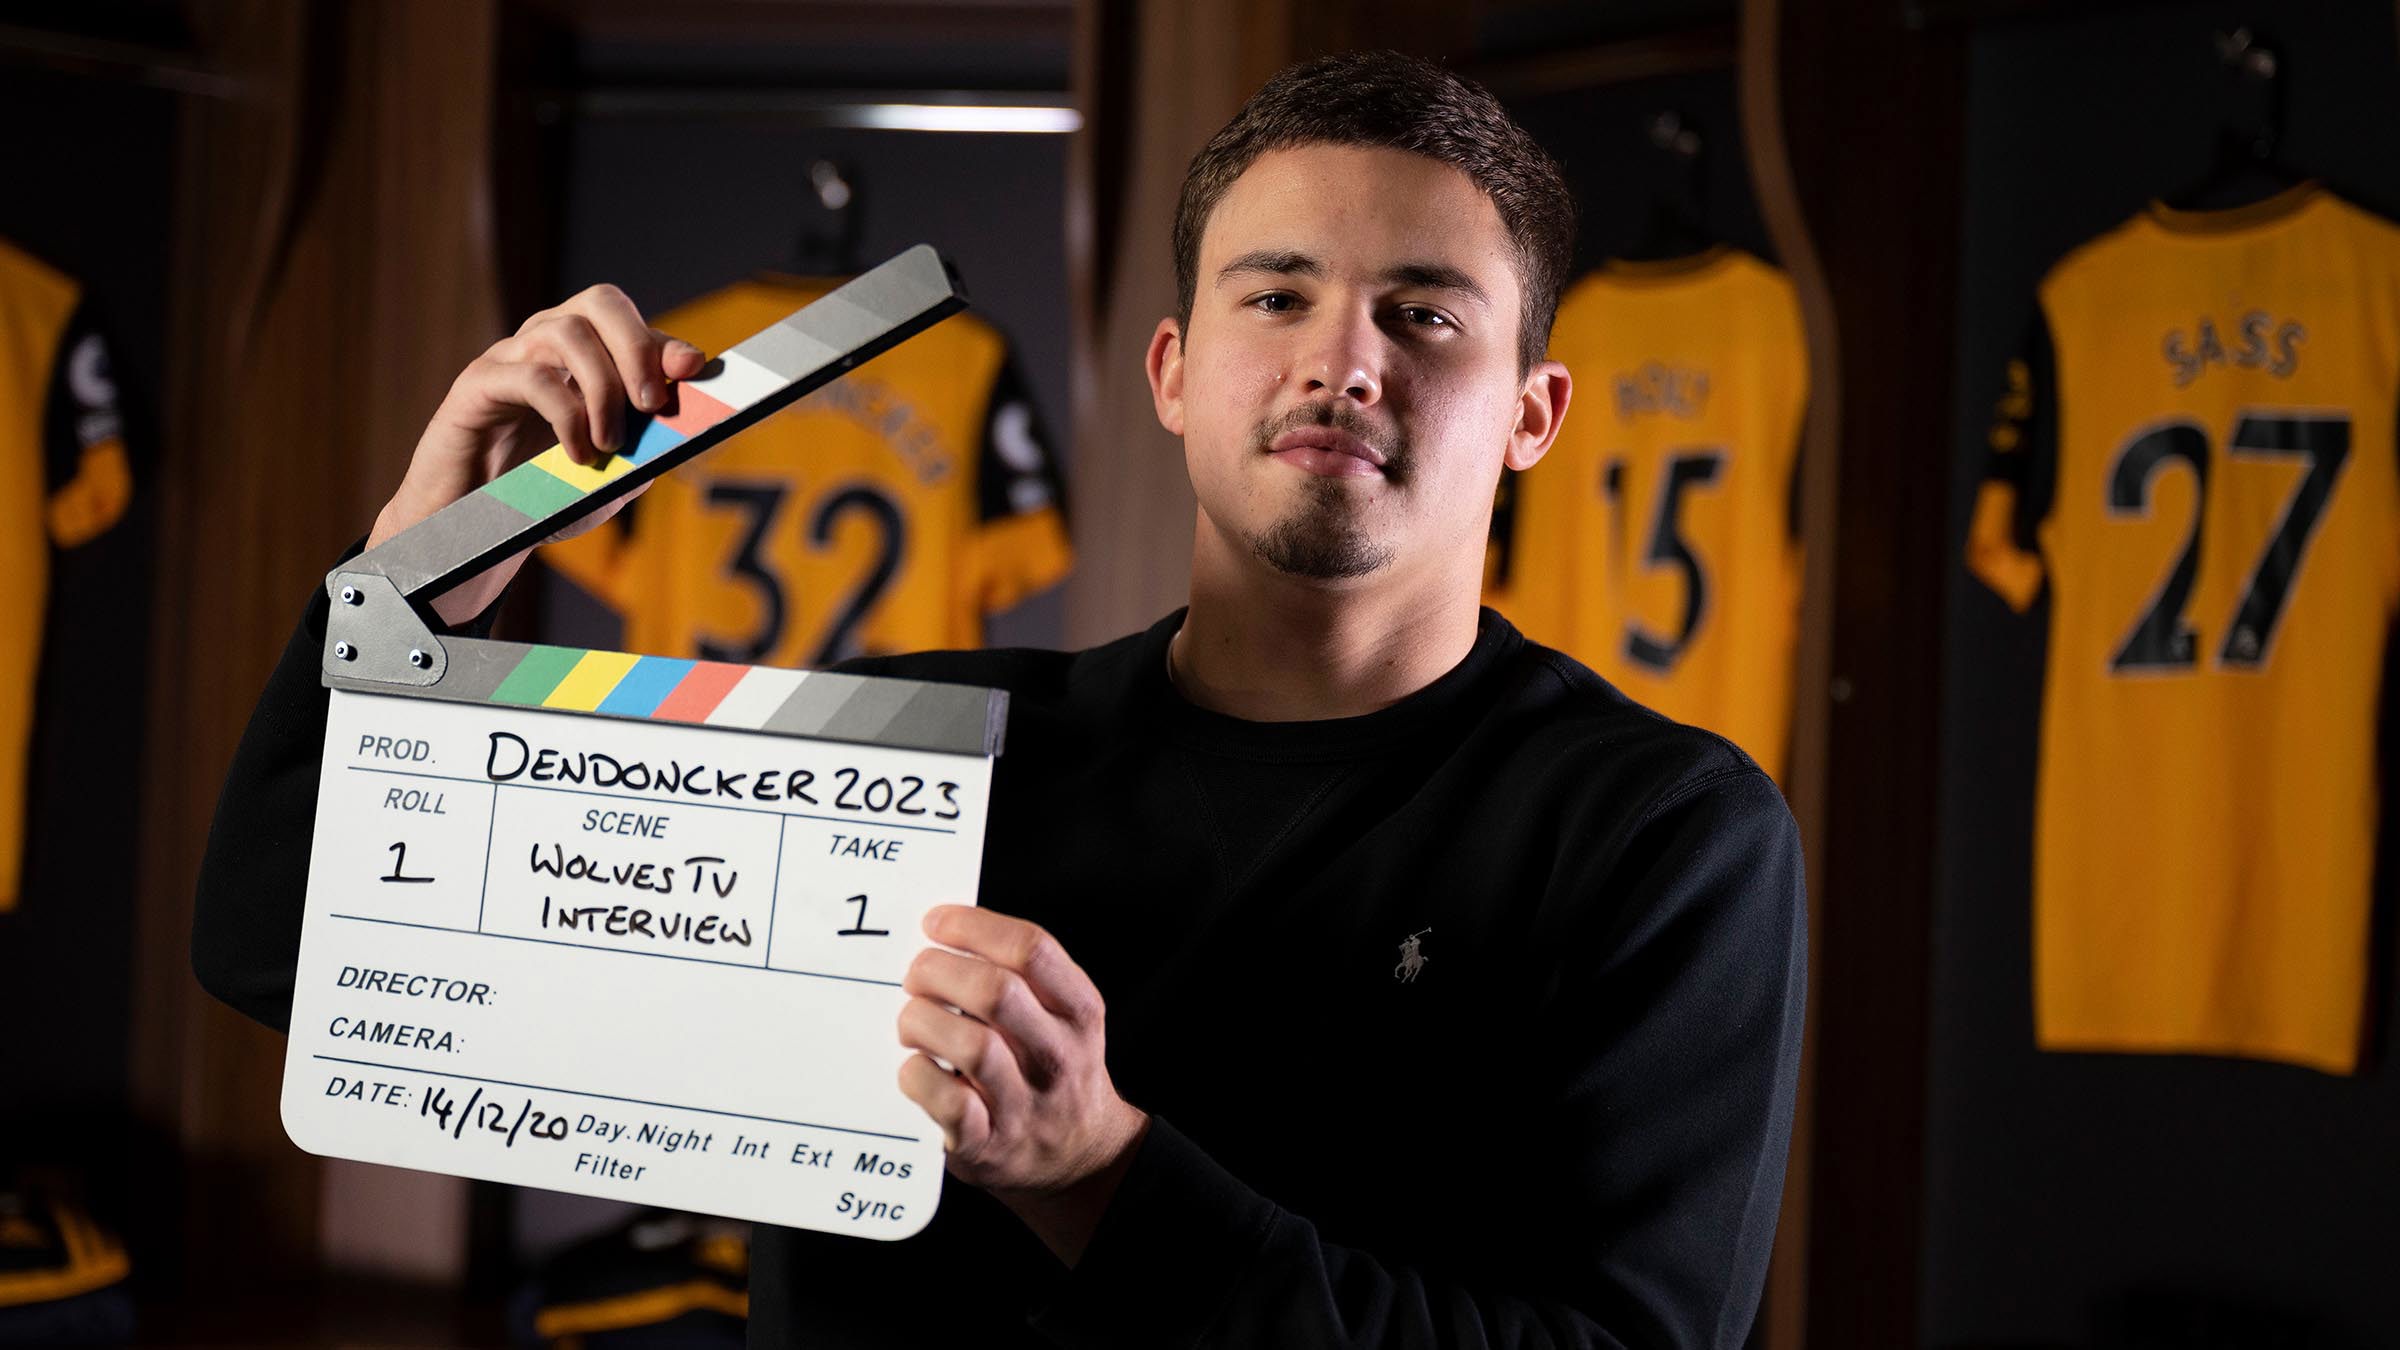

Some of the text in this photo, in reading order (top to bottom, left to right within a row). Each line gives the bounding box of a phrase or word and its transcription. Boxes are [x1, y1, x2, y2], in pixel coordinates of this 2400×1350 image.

[2104, 408, 2353, 677] 27
[695, 478, 912, 664] 32
[358, 734, 437, 764] PROD.
[487, 732, 961, 820] DENDONCKER 2023
[383, 788, 446, 815] ROLL
[582, 809, 670, 839] SCENE
[379, 842, 435, 884] 1
[530, 842, 675, 894] WOLVES
[829, 834, 904, 862] TAKE
[541, 896, 752, 947] INTERVIEW
[837, 894, 890, 936] 1
[336, 966, 498, 1006] DIRECTOR:
[329, 1016, 465, 1054] CAMERA:
[325, 1076, 413, 1108] DATE:
[420, 1087, 569, 1148] 14/12/20
[574, 1152, 646, 1181] Filter
[732, 1135, 771, 1159] Int
[791, 1143, 833, 1168] Ext
[853, 1152, 913, 1179] Mos
[836, 1192, 905, 1221] Sync
